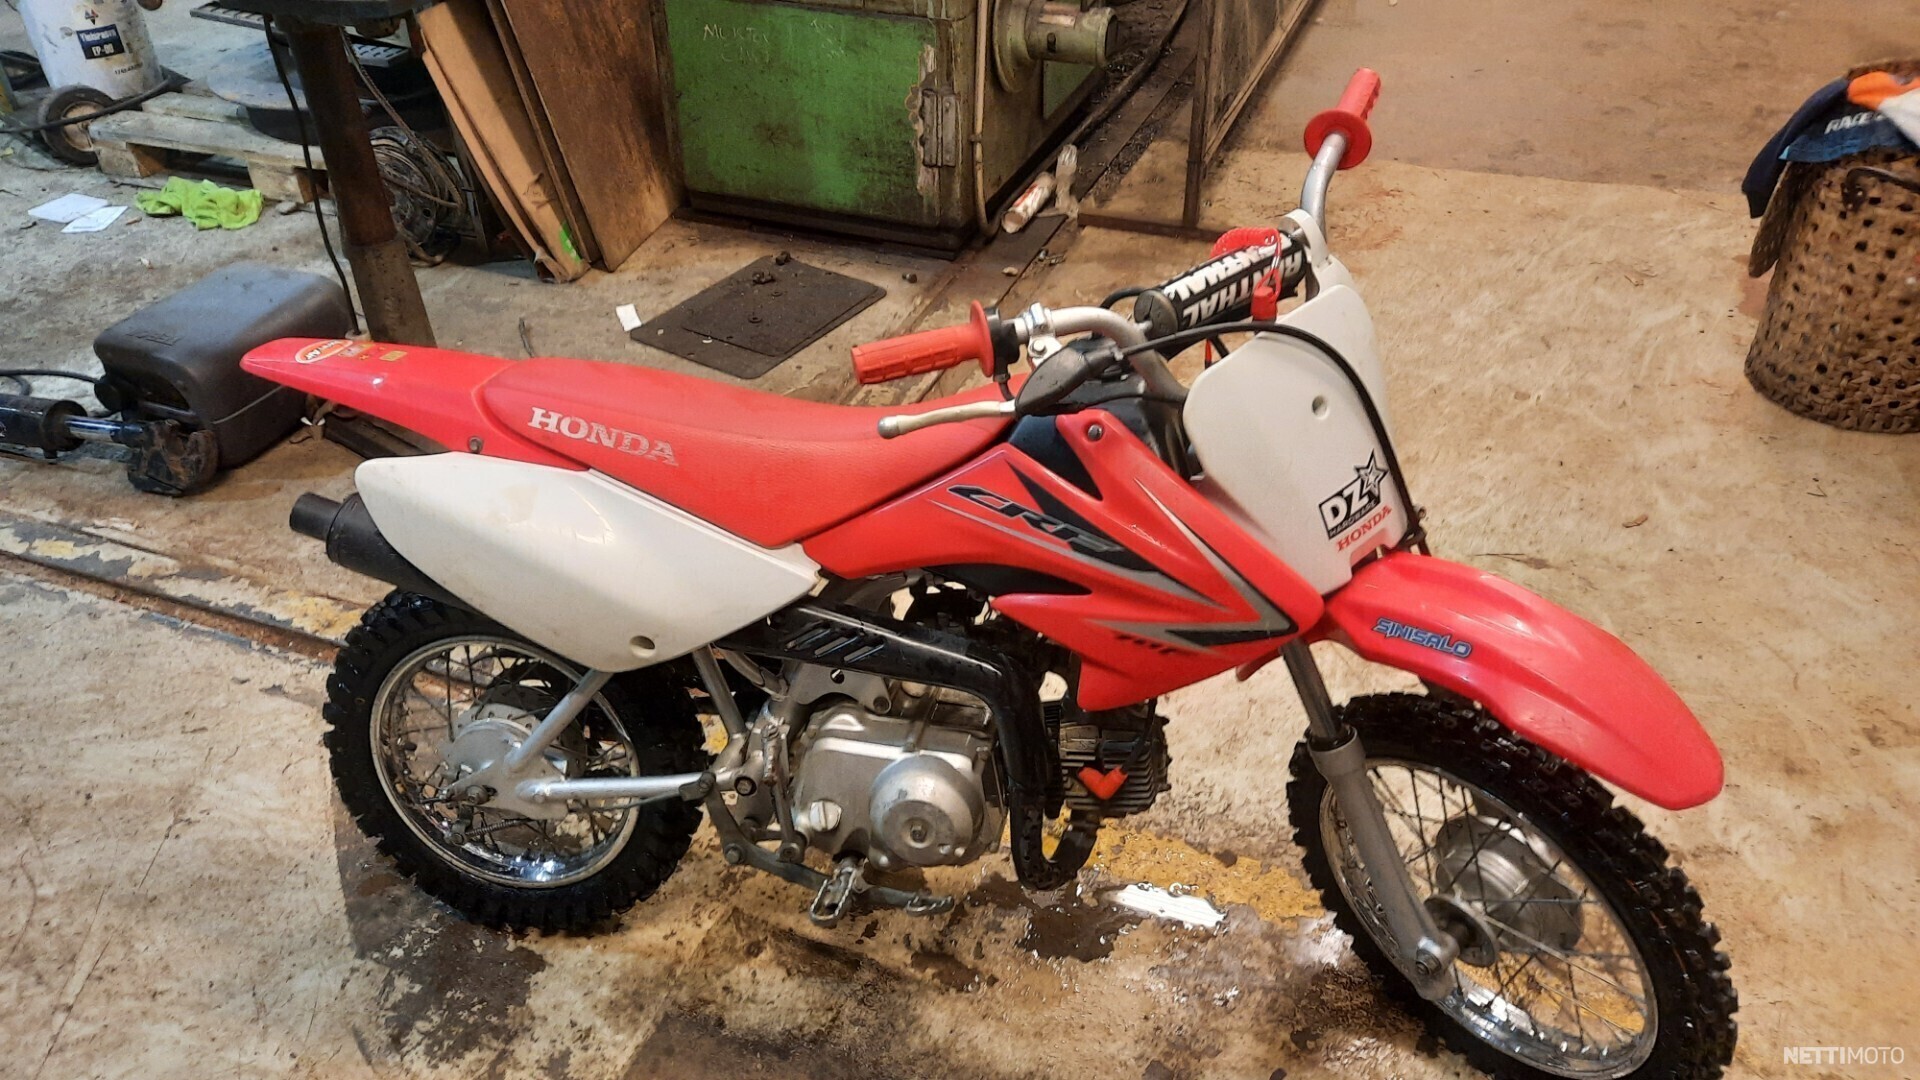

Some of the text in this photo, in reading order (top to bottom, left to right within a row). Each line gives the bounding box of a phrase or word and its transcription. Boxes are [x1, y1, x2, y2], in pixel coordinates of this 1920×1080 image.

[528, 406, 679, 467] HONDA
[1320, 479, 1369, 530] DZ
[1336, 505, 1391, 552] HONDA
[1372, 617, 1472, 658] SINISALO
